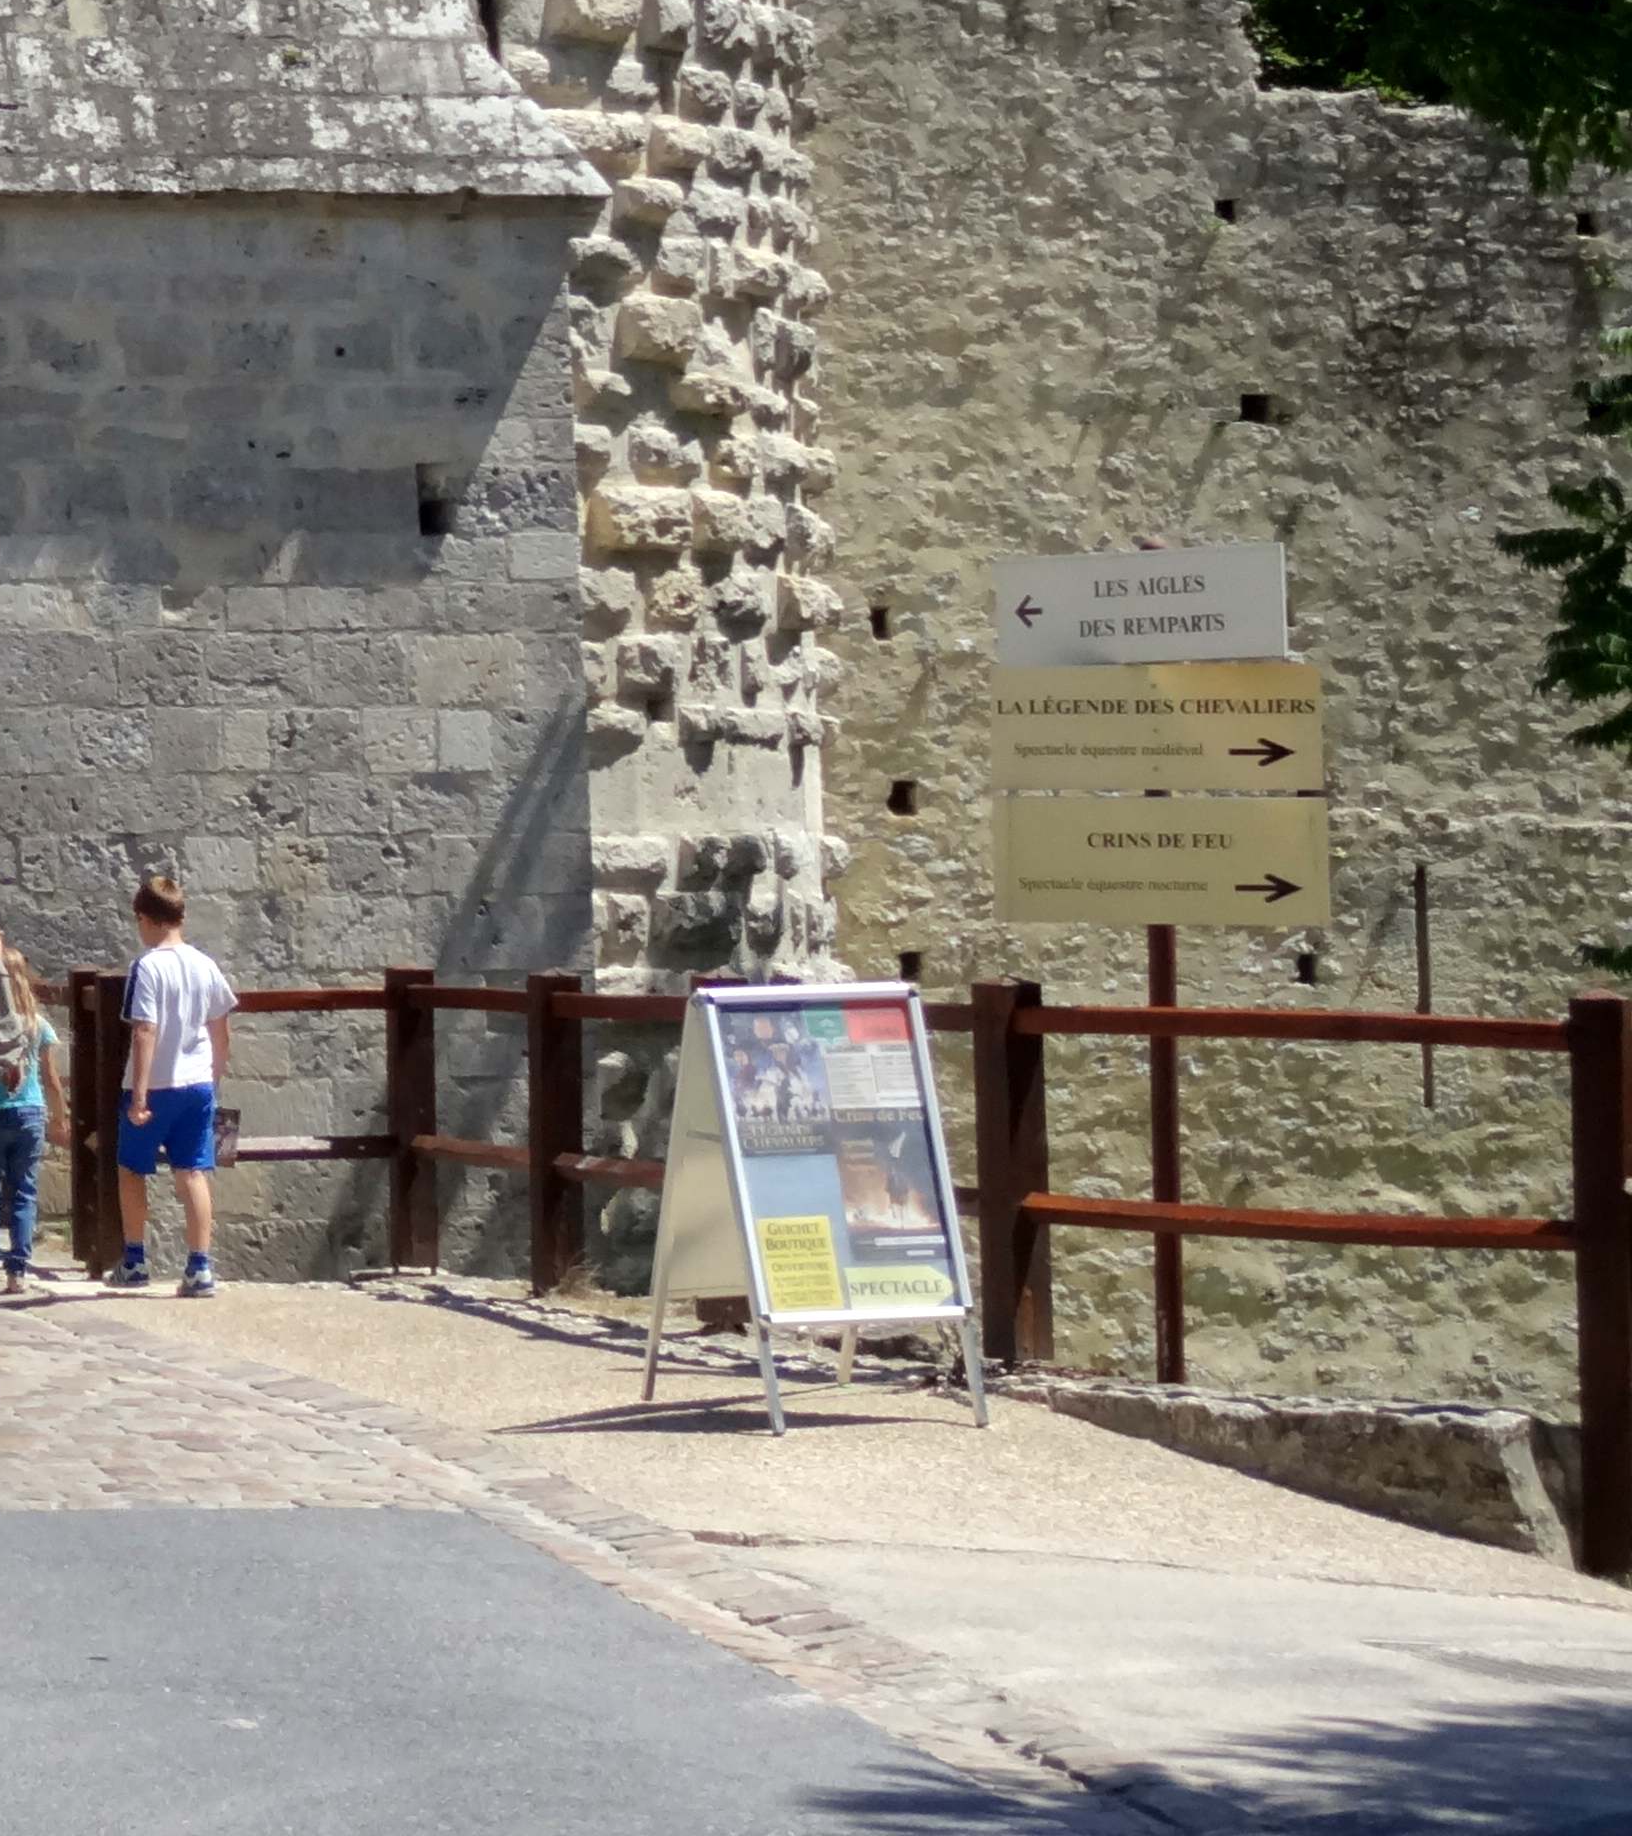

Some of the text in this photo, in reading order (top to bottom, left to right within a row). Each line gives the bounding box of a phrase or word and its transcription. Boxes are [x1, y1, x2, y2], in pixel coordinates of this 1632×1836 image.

[1093, 574, 1206, 598] LES AIGLES
[1079, 613, 1226, 638] DES REMPARTS
[996, 694, 1316, 715] LA LÉGENDE DES CHEVALIERS
[1014, 743, 1077, 759] Spectacle
[1087, 831, 1233, 850] CRINS DE FEU
[1018, 877, 1084, 893] Spectacle
[1147, 878, 1209, 892] nocturne
[765, 1237, 827, 1252] BOUTIQUE
[850, 1278, 944, 1296] SPECTACLE
